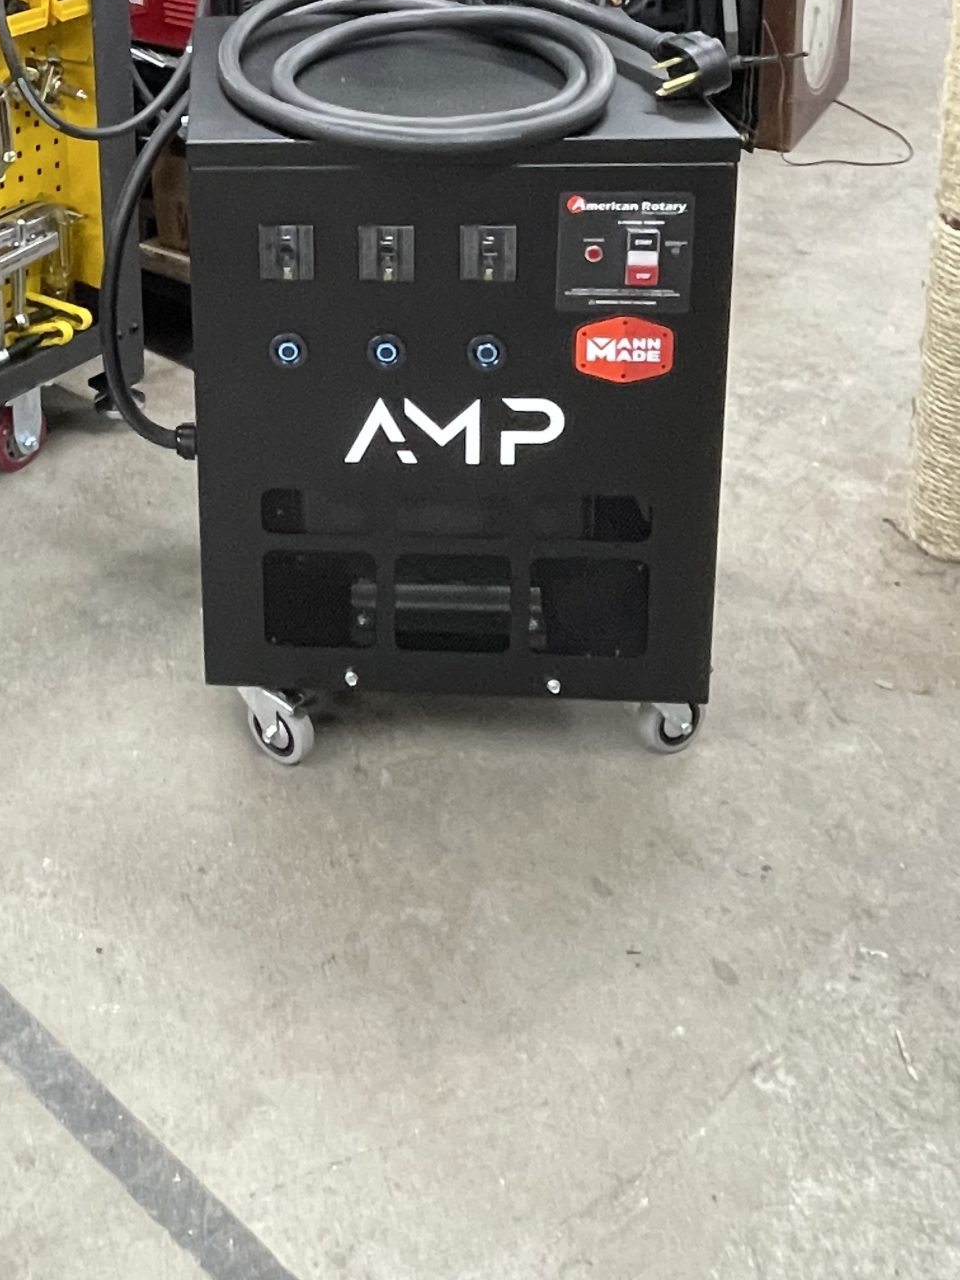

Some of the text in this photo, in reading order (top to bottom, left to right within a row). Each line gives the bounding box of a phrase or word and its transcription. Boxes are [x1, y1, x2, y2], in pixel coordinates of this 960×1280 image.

[571, 198, 688, 214] American Rotary
[344, 397, 566, 466] AMP
